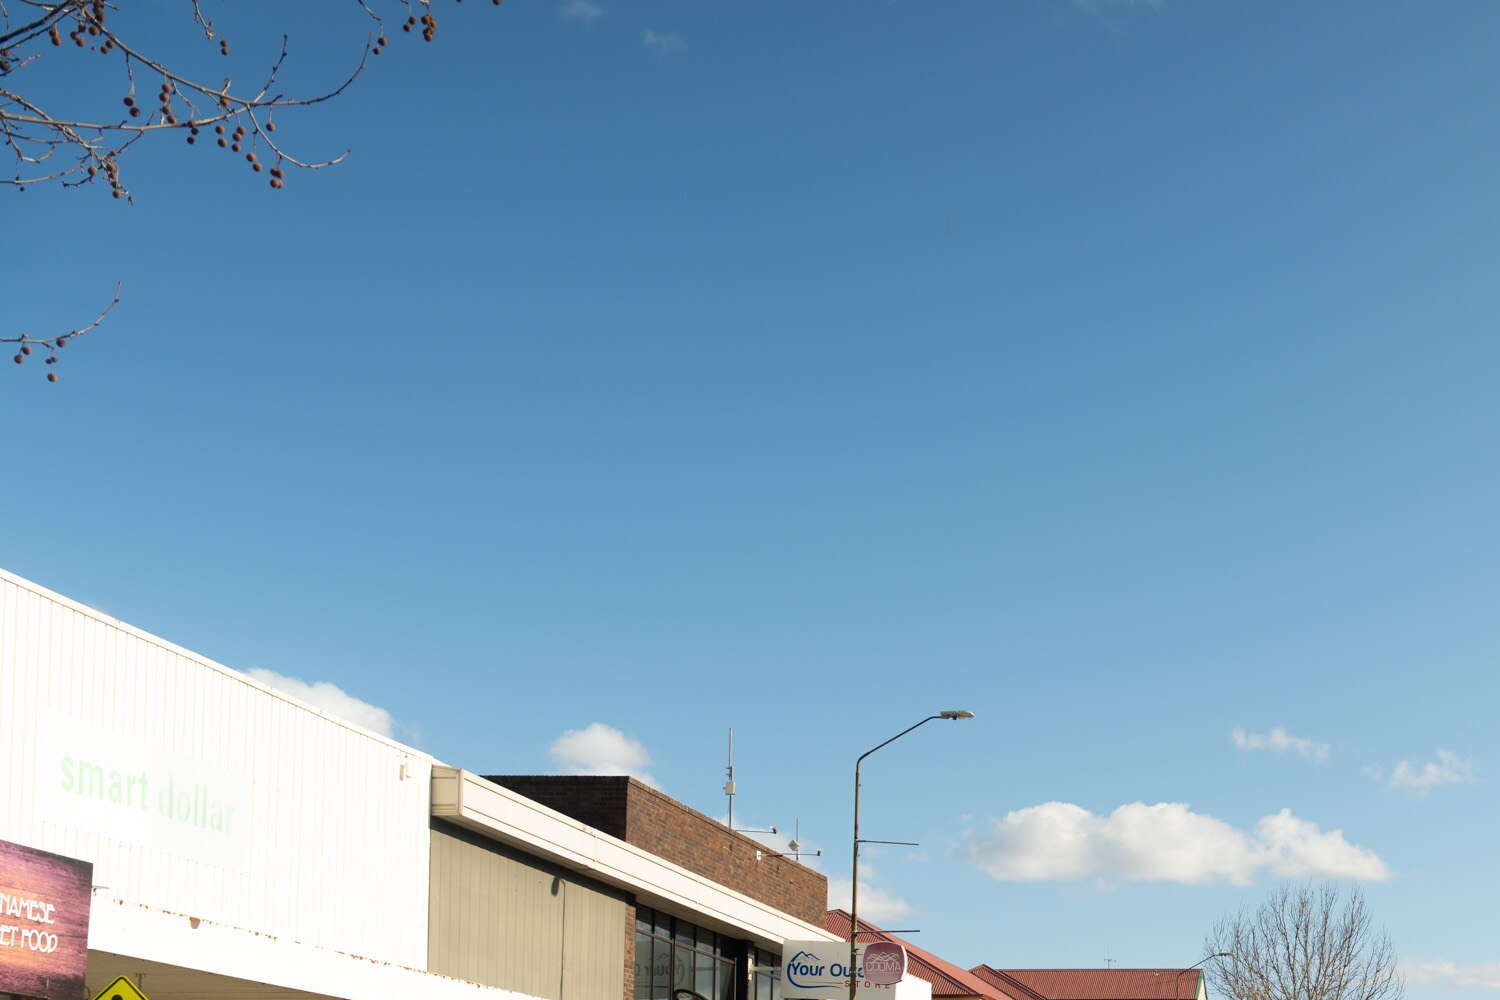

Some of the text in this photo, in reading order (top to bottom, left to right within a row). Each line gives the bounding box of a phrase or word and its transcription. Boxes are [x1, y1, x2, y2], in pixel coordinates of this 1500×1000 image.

[60, 755, 235, 834] smart dollar
[20, 928, 58, 953] FOOD
[791, 962, 825, 976] Your
[865, 961, 901, 973] COOMA
